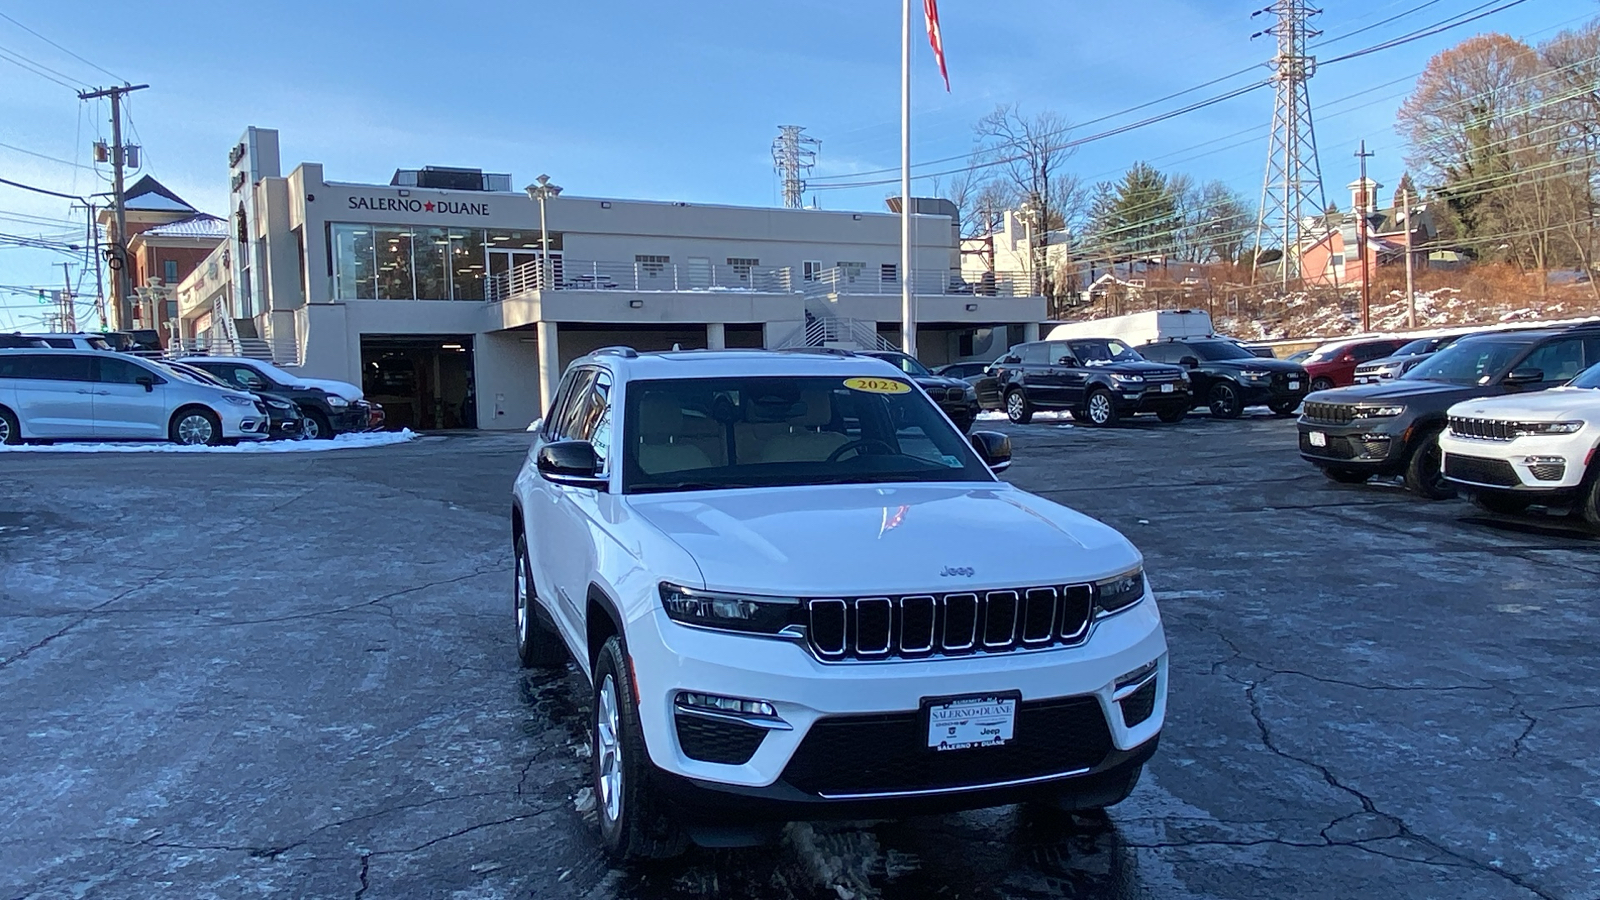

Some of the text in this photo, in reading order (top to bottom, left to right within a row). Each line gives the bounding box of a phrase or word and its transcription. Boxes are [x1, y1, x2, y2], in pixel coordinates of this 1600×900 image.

[348, 196, 490, 216] SALERNO DUANE
[857, 380, 899, 391] 2023
[940, 565, 975, 578] Jeep
[932, 706, 1012, 719] SALERNO DUANE
